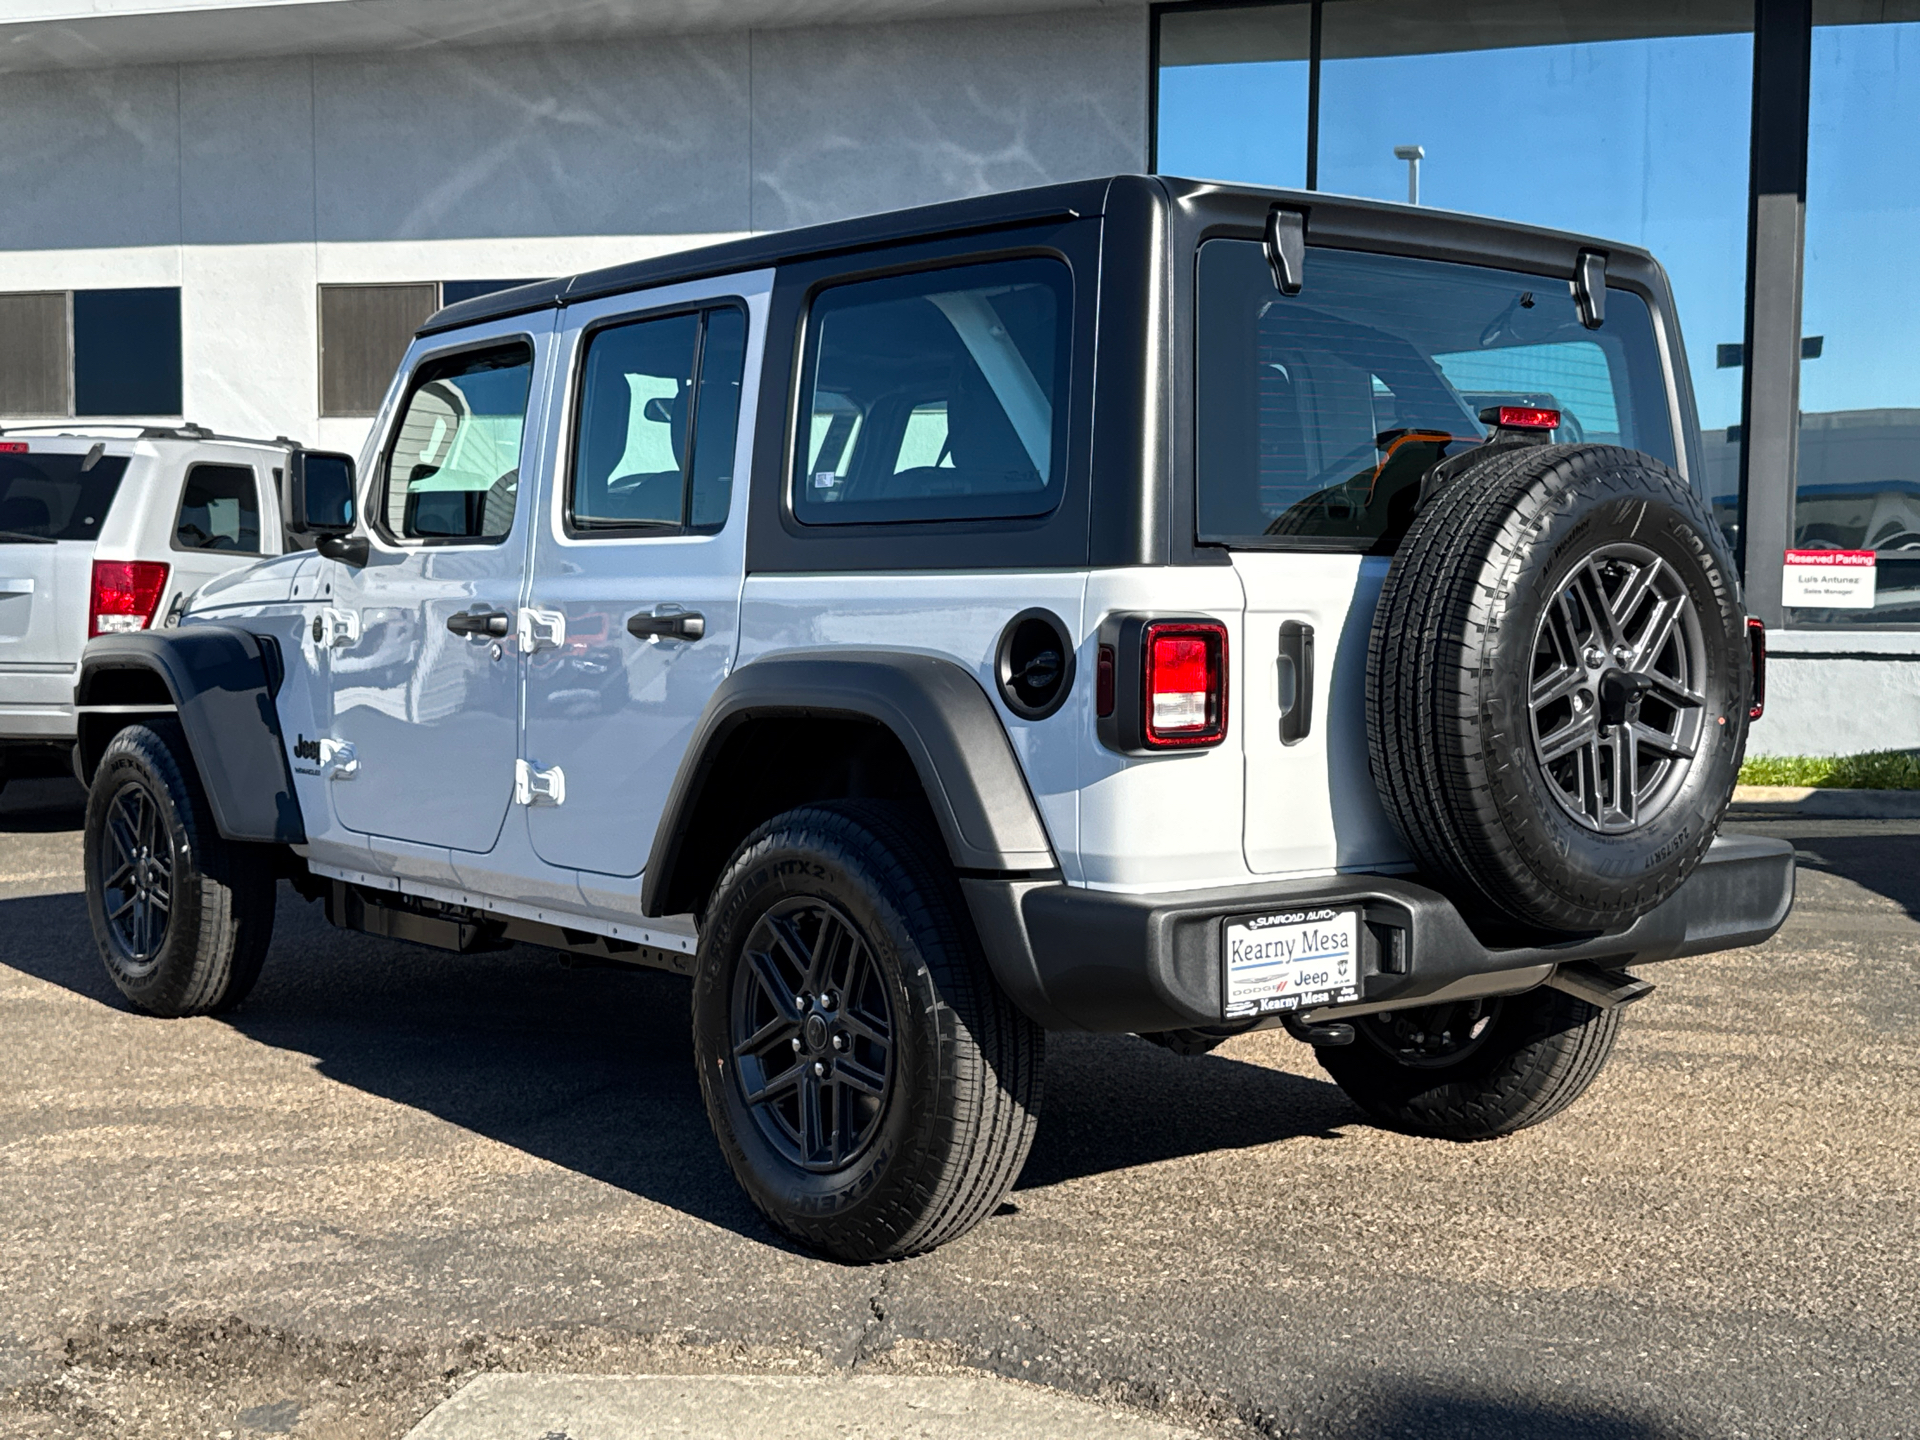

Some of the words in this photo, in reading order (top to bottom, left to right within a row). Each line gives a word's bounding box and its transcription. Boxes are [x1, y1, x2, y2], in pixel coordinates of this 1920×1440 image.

[1786, 553, 1834, 565] Reserved
[1835, 554, 1874, 567] Parking
[1798, 575, 1819, 584] Luis
[1820, 575, 1860, 585] Antunez
[1823, 588, 1854, 596] Manager
[1644, 826, 1690, 869] 245/75R17
[773, 858, 826, 882] HTX2
[1256, 912, 1305, 926] SUNROAD
[1306, 909, 1332, 921] AUTO
[1231, 938, 1296, 965] Kearny
[1301, 929, 1349, 954] Mesa
[1294, 970, 1329, 987] Jeep
[1232, 984, 1279, 996] DODGE
[1260, 993, 1299, 1011] Kearny
[1301, 991, 1329, 1005] Mesa
[799, 1147, 888, 1212] NEXEN
